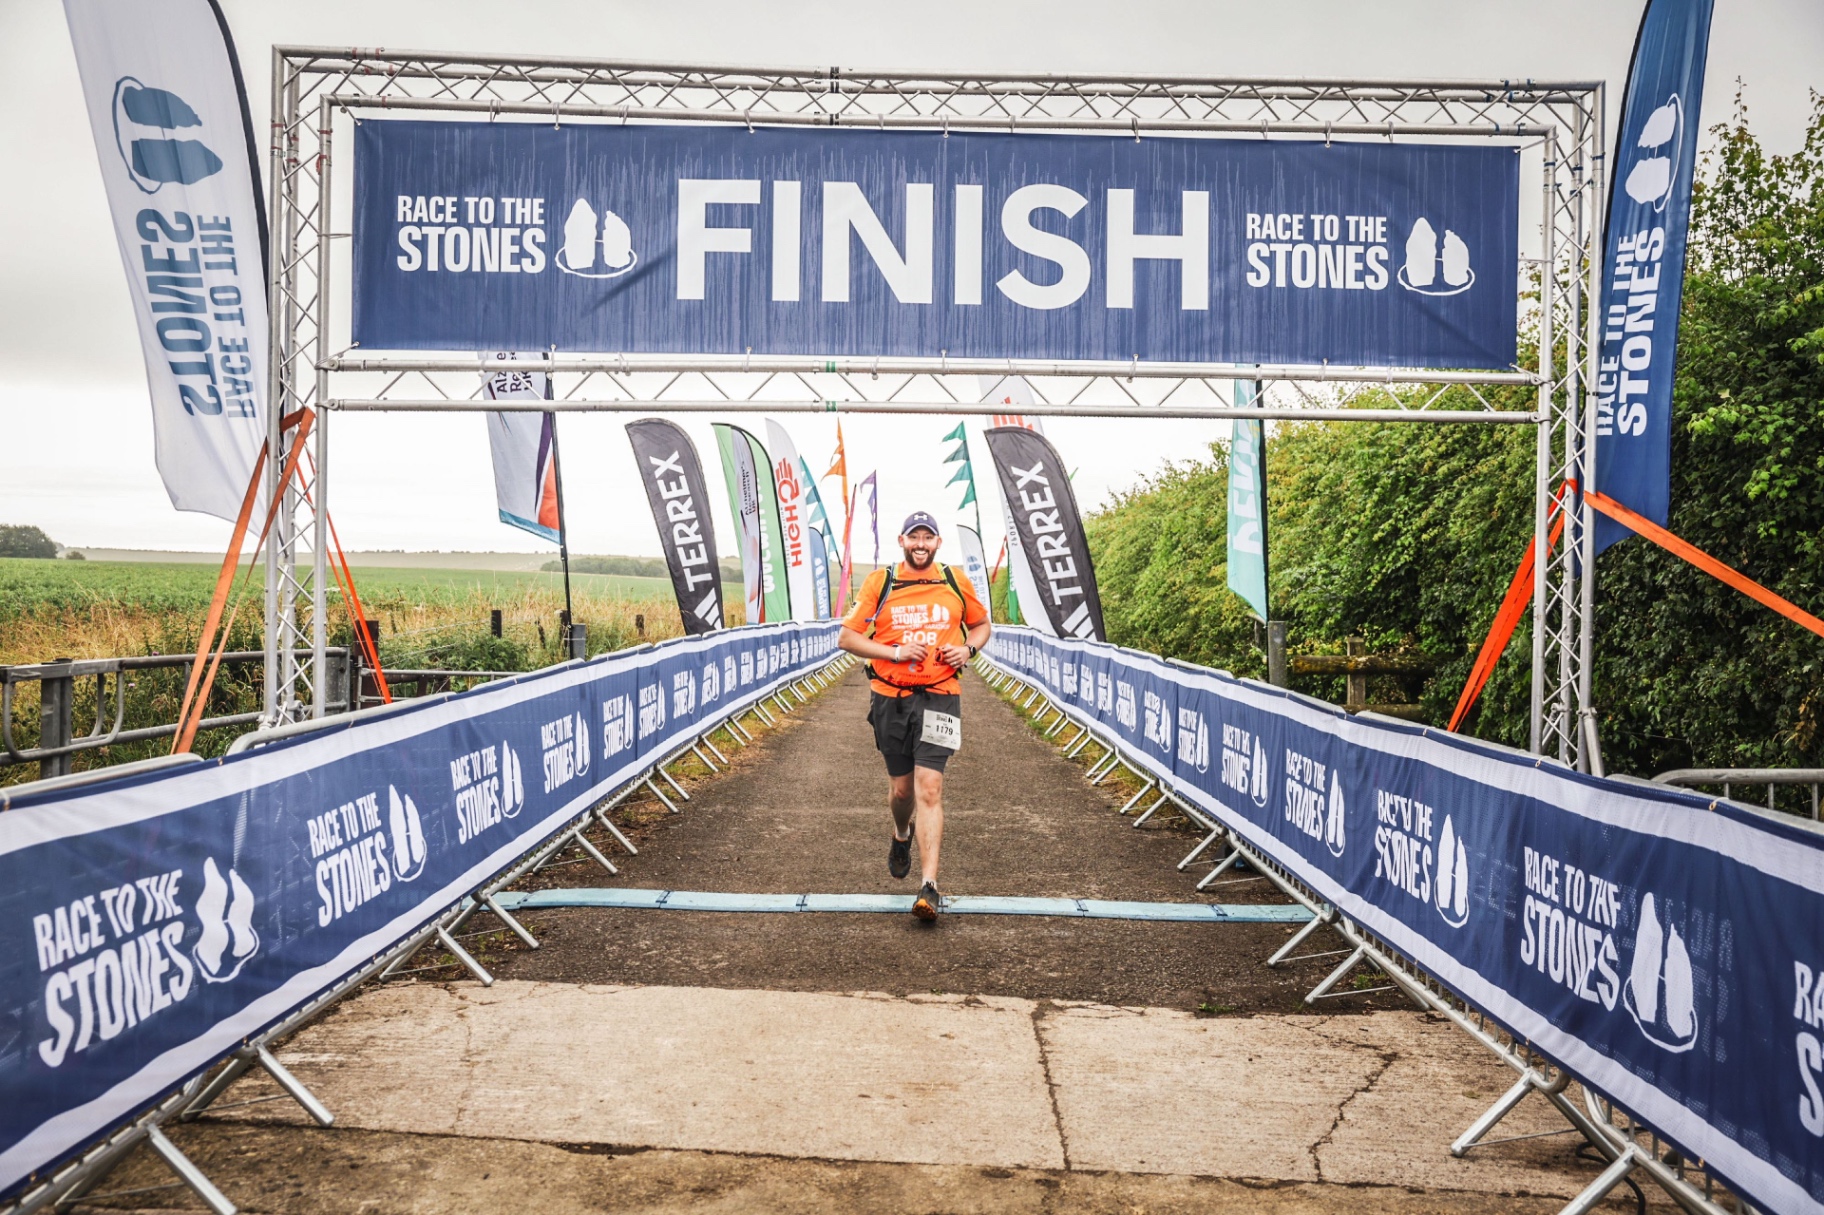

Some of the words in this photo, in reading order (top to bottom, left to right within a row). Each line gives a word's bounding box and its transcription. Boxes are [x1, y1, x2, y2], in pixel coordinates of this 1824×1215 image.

[396, 194, 457, 224] RACE
[464, 196, 496, 225] TO
[500, 197, 545, 225] THE
[1246, 212, 1304, 240] RACE
[1310, 214, 1340, 242] TO
[1345, 216, 1387, 243] THE
[396, 226, 547, 274] STONES
[676, 179, 1210, 310] FINISH
[1246, 243, 1389, 291] STONES
[1612, 233, 1638, 295] THE
[1617, 226, 1665, 437] STONES
[649, 449, 713, 592] TERREX
[1011, 460, 1086, 605] TERREX
[892, 612, 929, 625] STONES
[902, 630, 938, 646] ROB
[936, 725, 954, 735] 1179
[450, 755, 471, 791] RACE
[470, 751, 482, 781] TO
[481, 745, 498, 776] THE
[543, 740, 574, 794] STONES
[1221, 746, 1251, 795] STONES
[1302, 756, 1313, 786] TO
[1313, 761, 1326, 792] THE
[306, 808, 343, 859] RACE
[339, 801, 360, 842] TO
[355, 792, 382, 833] THE
[456, 776, 502, 845] STONES
[1285, 777, 1325, 841] STONES
[1414, 801, 1433, 842] THE
[315, 831, 391, 928] STONES
[1374, 825, 1432, 904] STONES
[1523, 845, 1560, 902] RACE
[1563, 862, 1585, 914] TO
[34, 894, 106, 973] RACE
[100, 883, 137, 939] TO
[136, 869, 184, 926] THE
[1520, 894, 1621, 1012] STONES
[38, 920, 194, 1068] STONES
